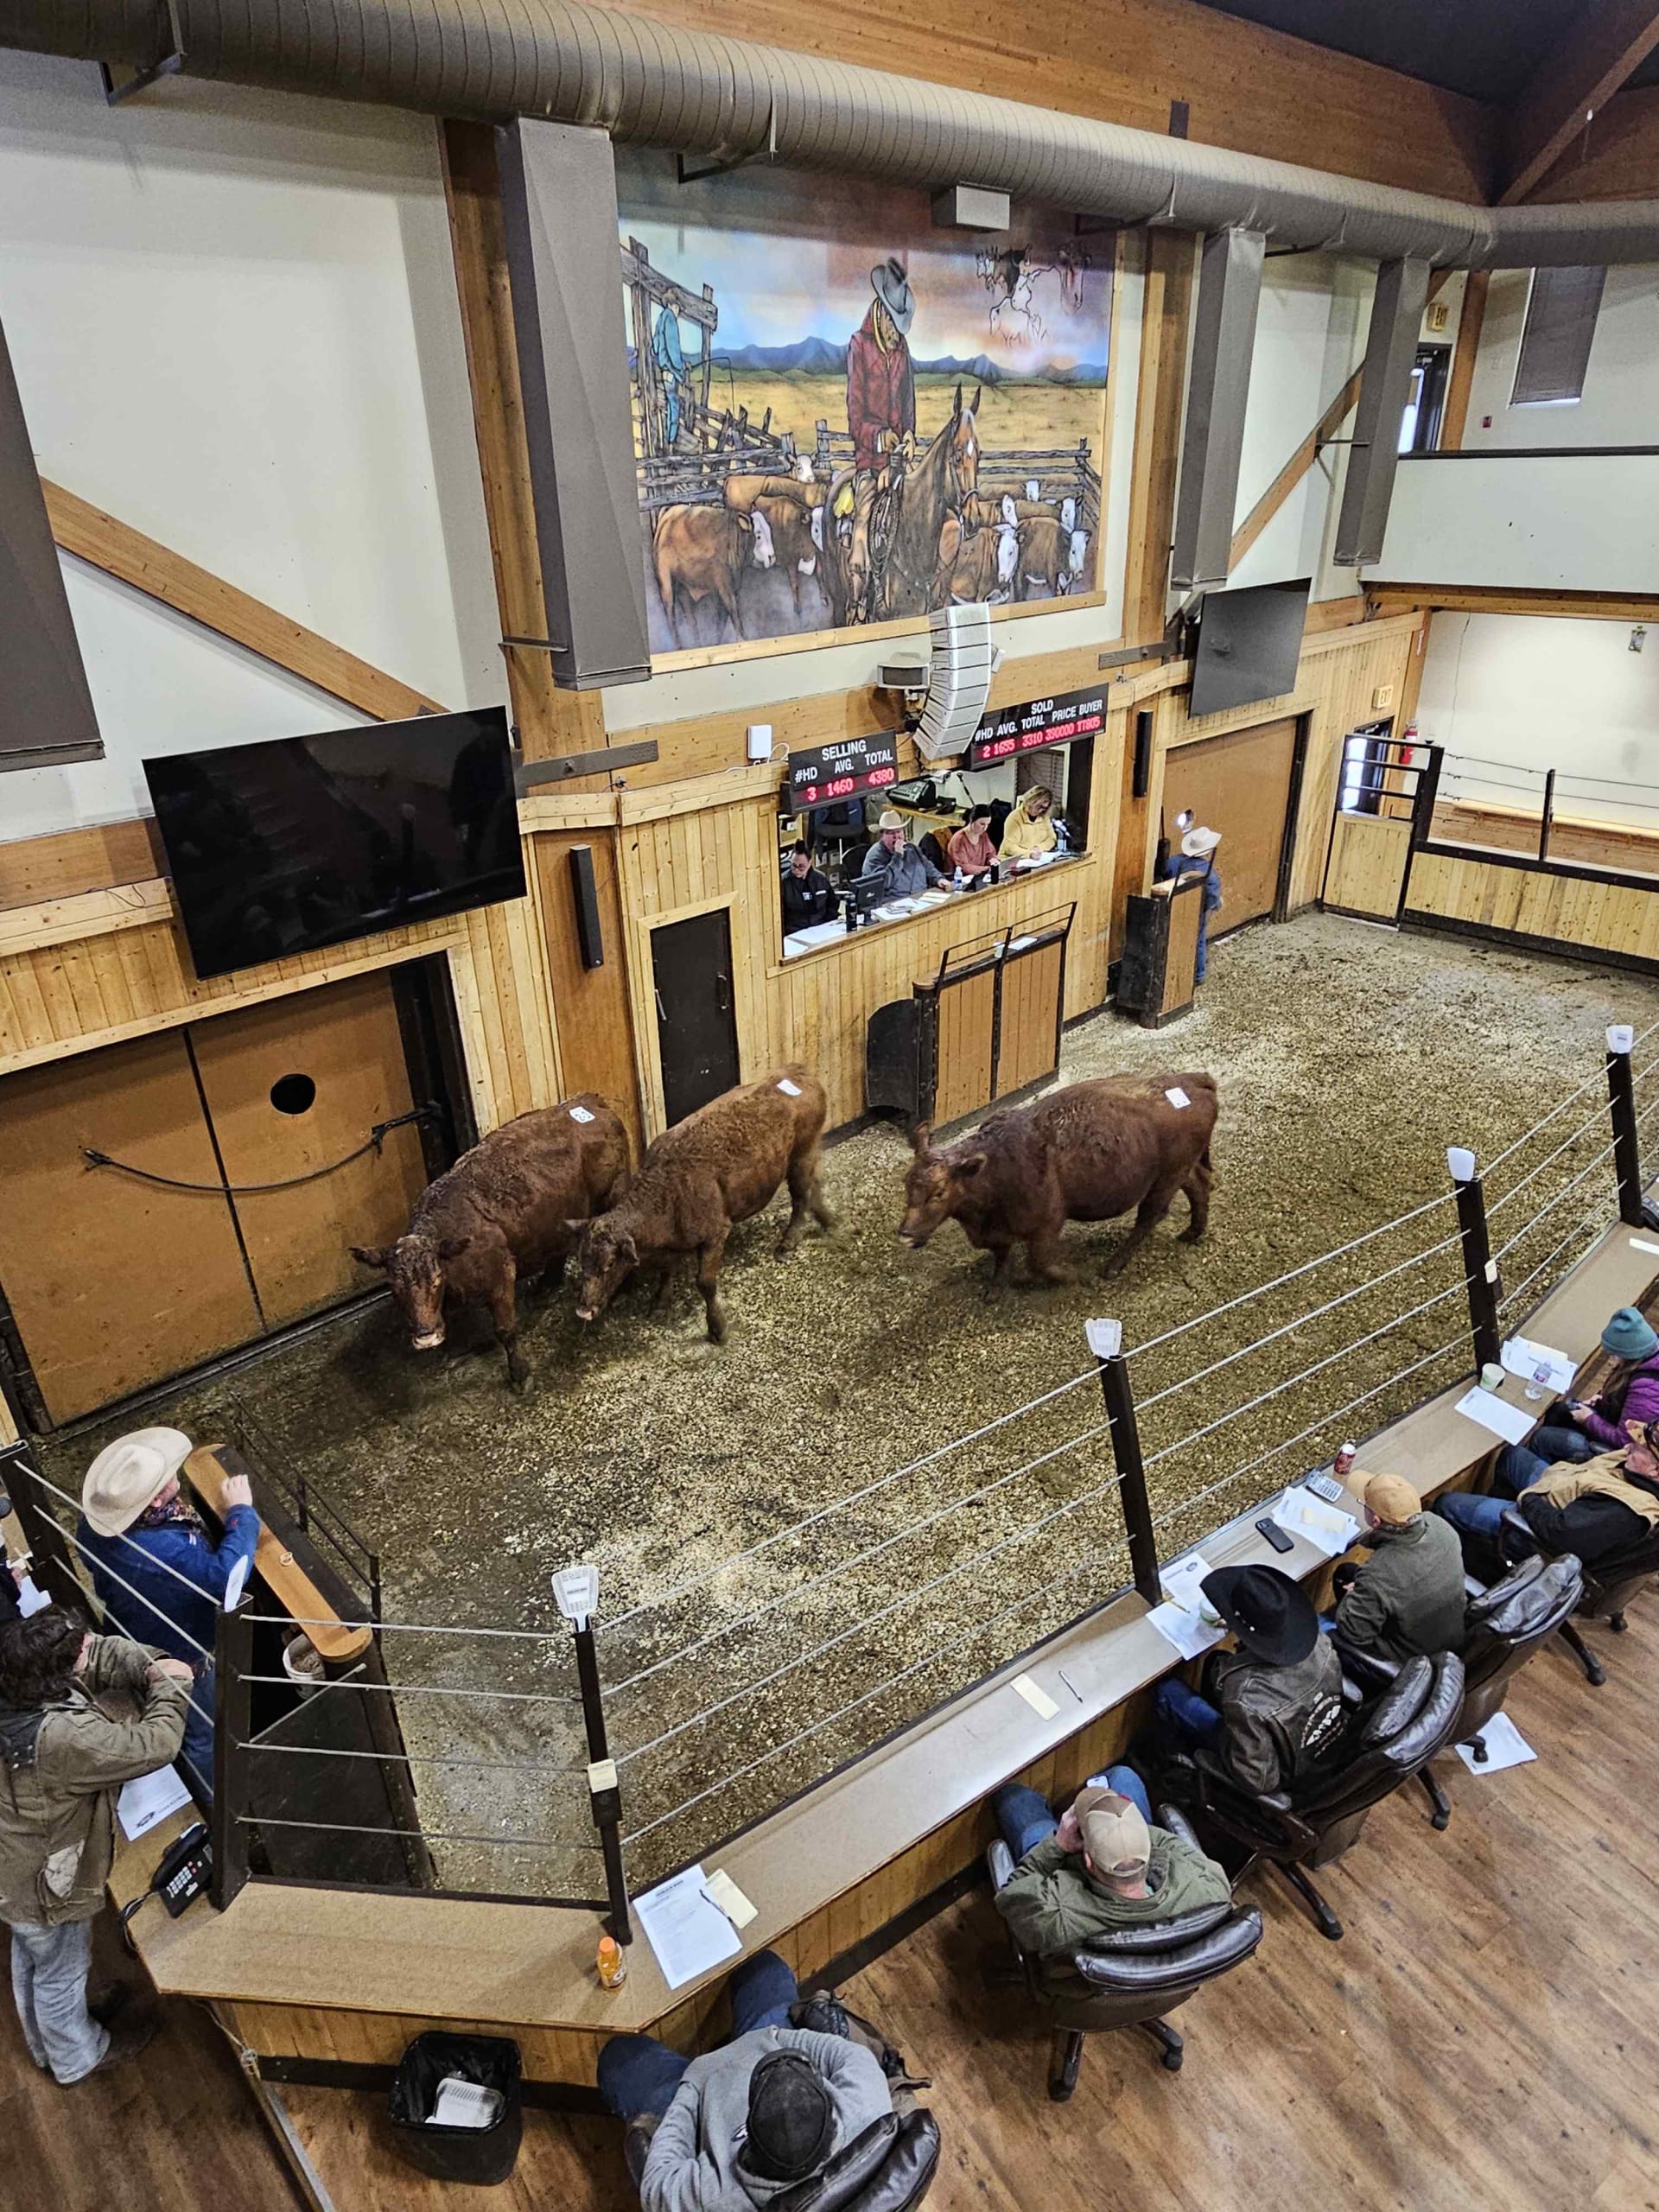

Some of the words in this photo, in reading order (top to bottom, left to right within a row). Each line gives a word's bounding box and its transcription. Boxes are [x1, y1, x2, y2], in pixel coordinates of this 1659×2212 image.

[997, 722, 1017, 735] AVG.
[1021, 715, 1045, 728] TOTAL
[1052, 707, 1076, 722] PRICE
[1079, 700, 1103, 715] BUYER
[1032, 700, 1053, 715] SOLD
[822, 740, 867, 760] SELLING
[983, 745, 990, 758] 2
[1022, 731, 1043, 747] 3310
[795, 766, 817, 783] #HD
[835, 759, 854, 773] AVG.
[865, 749, 893, 766] TOTAL
[806, 787, 817, 801] 3
[827, 779, 854, 796] 1460
[868, 768, 894, 785] 4380
